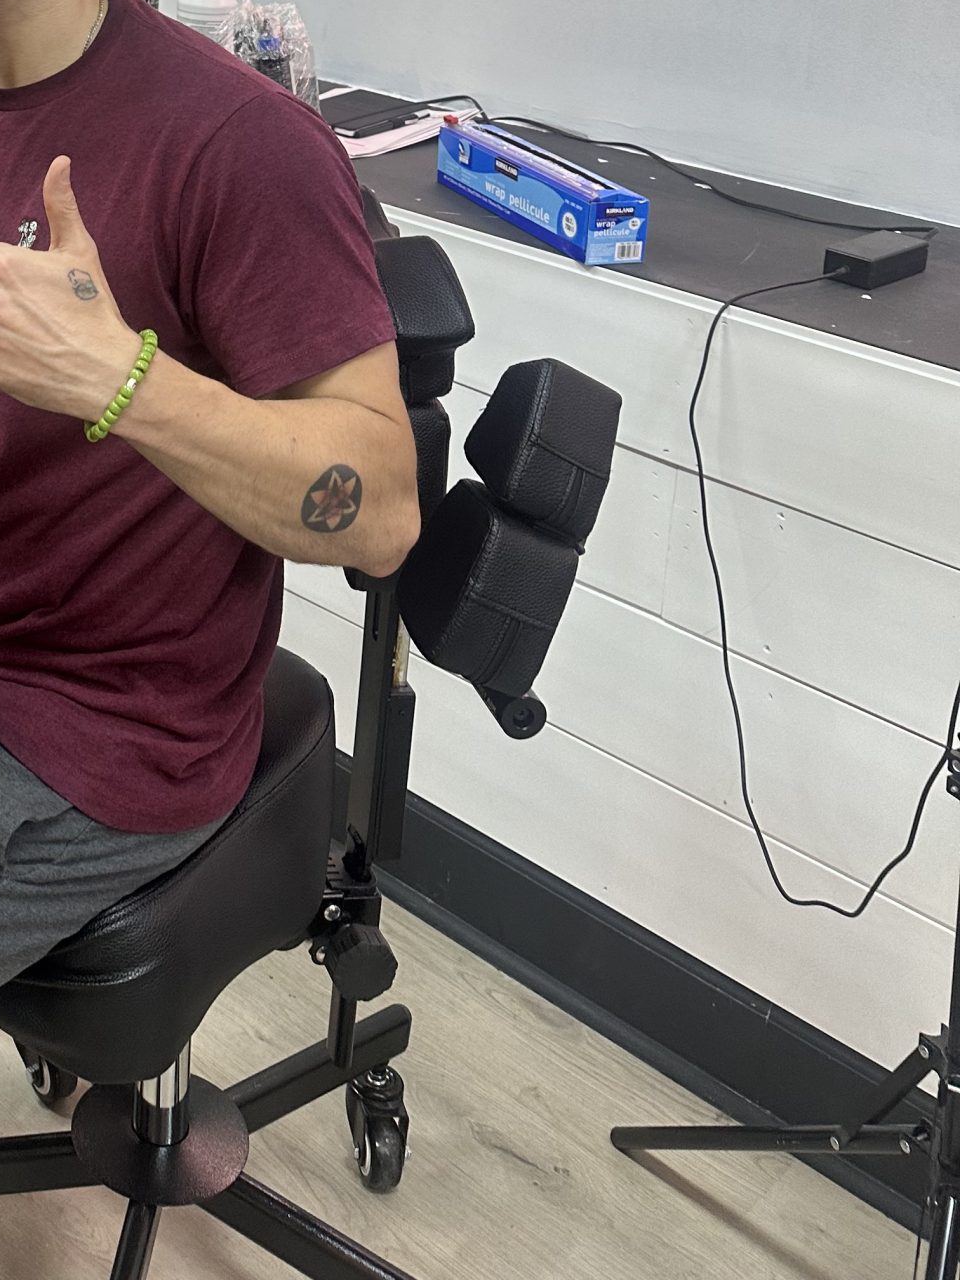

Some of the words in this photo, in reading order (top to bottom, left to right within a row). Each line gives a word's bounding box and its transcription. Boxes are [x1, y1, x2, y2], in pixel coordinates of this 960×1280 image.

[495, 159, 518, 177] KIRKLAND
[485, 181, 506, 201] wrap
[509, 194, 550, 224] pellicule
[596, 221, 616, 229] wrap
[593, 228, 630, 238] pellicule
